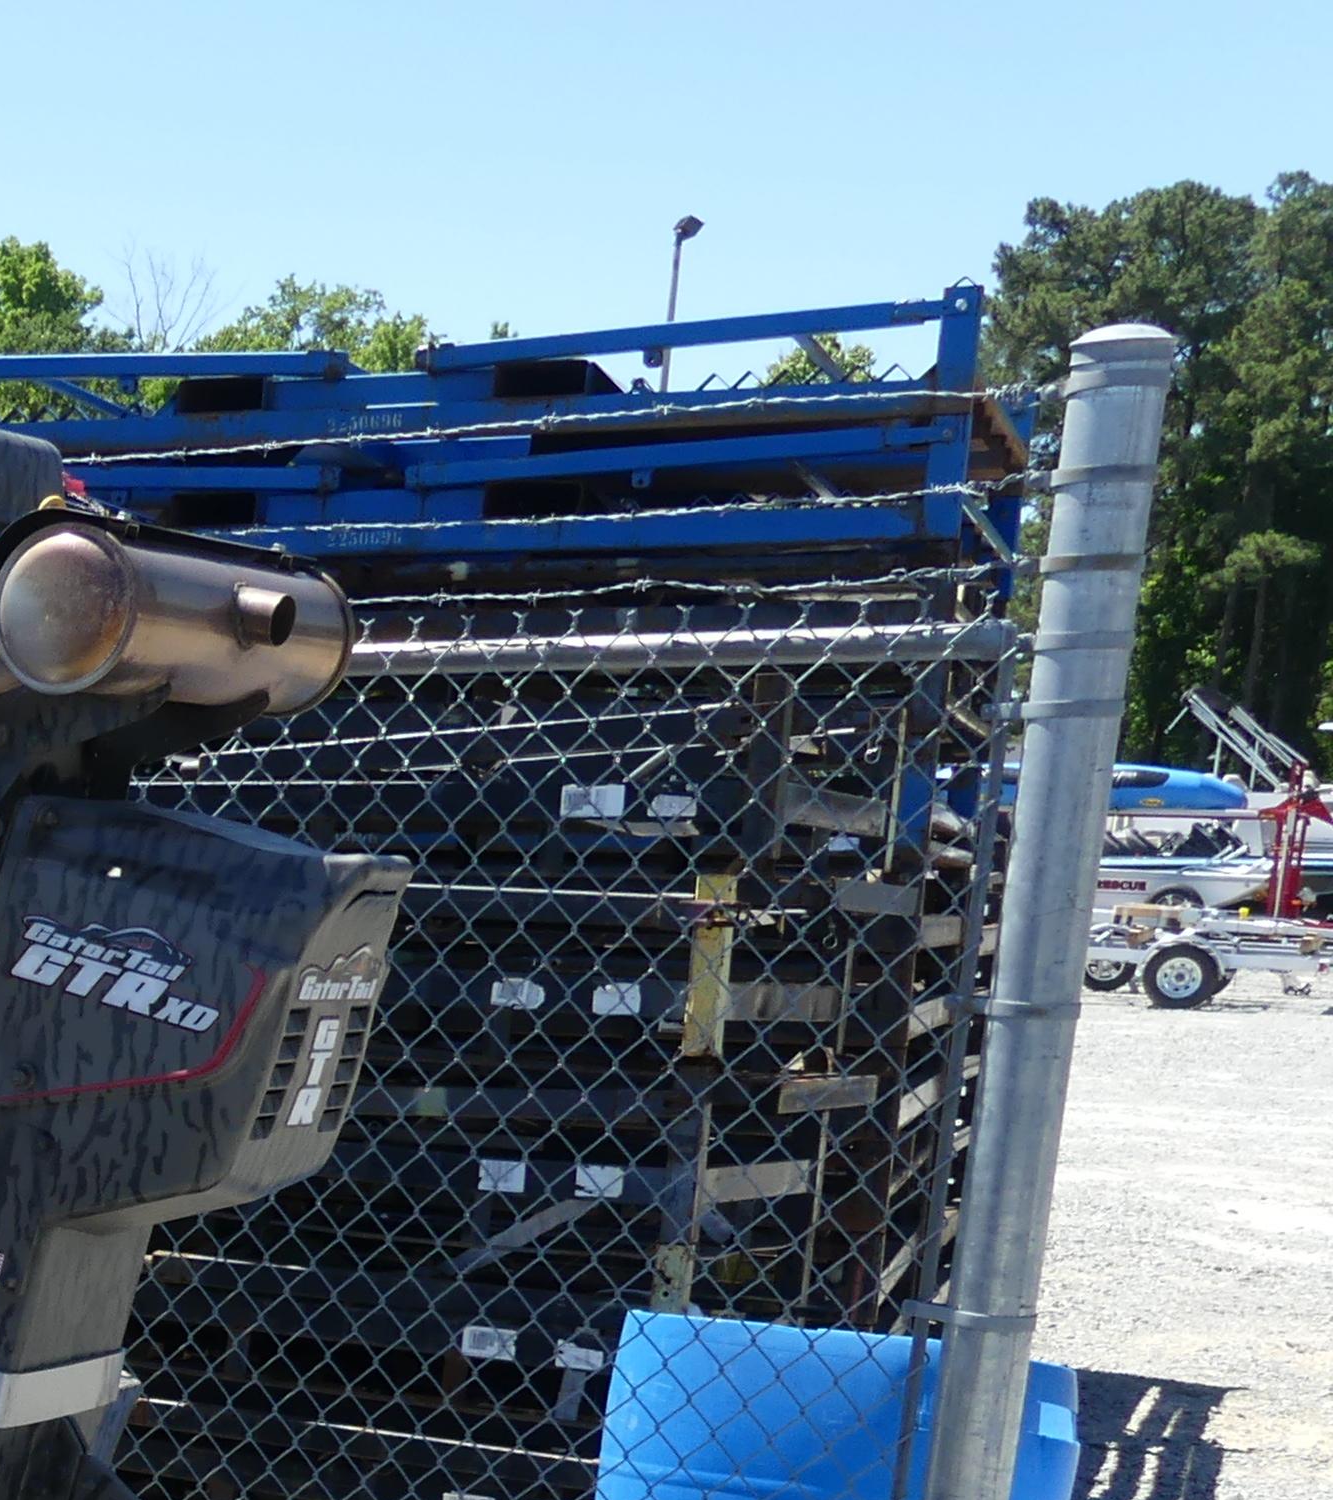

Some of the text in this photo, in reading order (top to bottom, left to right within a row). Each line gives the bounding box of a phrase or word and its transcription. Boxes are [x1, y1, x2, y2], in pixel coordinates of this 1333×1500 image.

[11, 944, 170, 1017] GTR
[24, 922, 185, 980] GatorTail
[298, 975, 378, 1001] GatorTail
[286, 1018, 340, 1127] GTR
